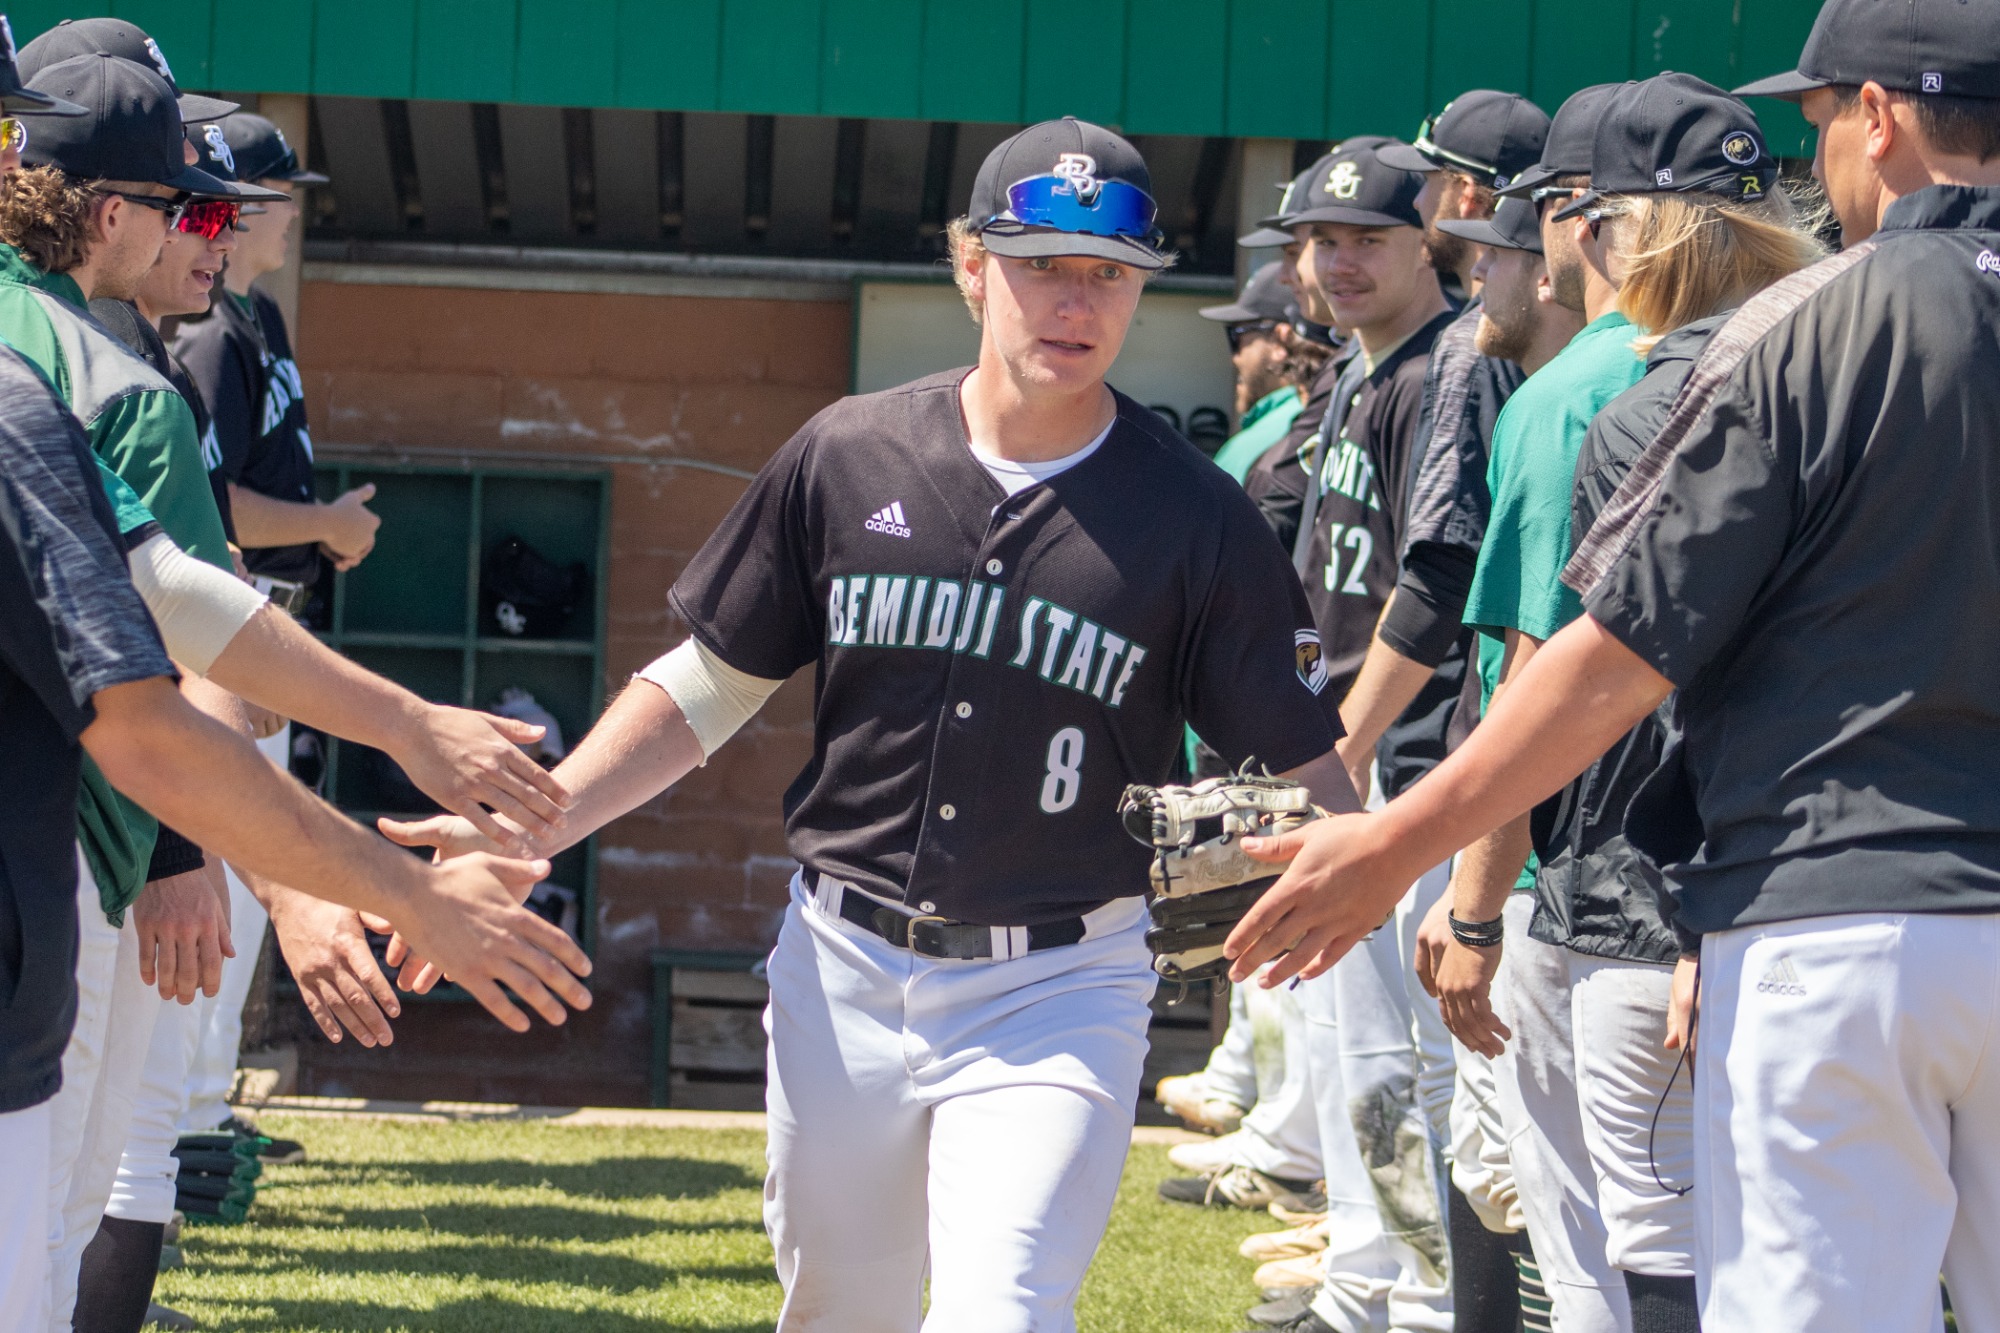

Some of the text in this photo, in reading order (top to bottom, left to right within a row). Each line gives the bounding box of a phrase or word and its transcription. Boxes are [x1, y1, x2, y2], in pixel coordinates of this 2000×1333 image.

[865, 519, 911, 538] adidas
[828, 574, 1149, 709] BEMIDJI STATE
[1040, 726, 1085, 813] 8
